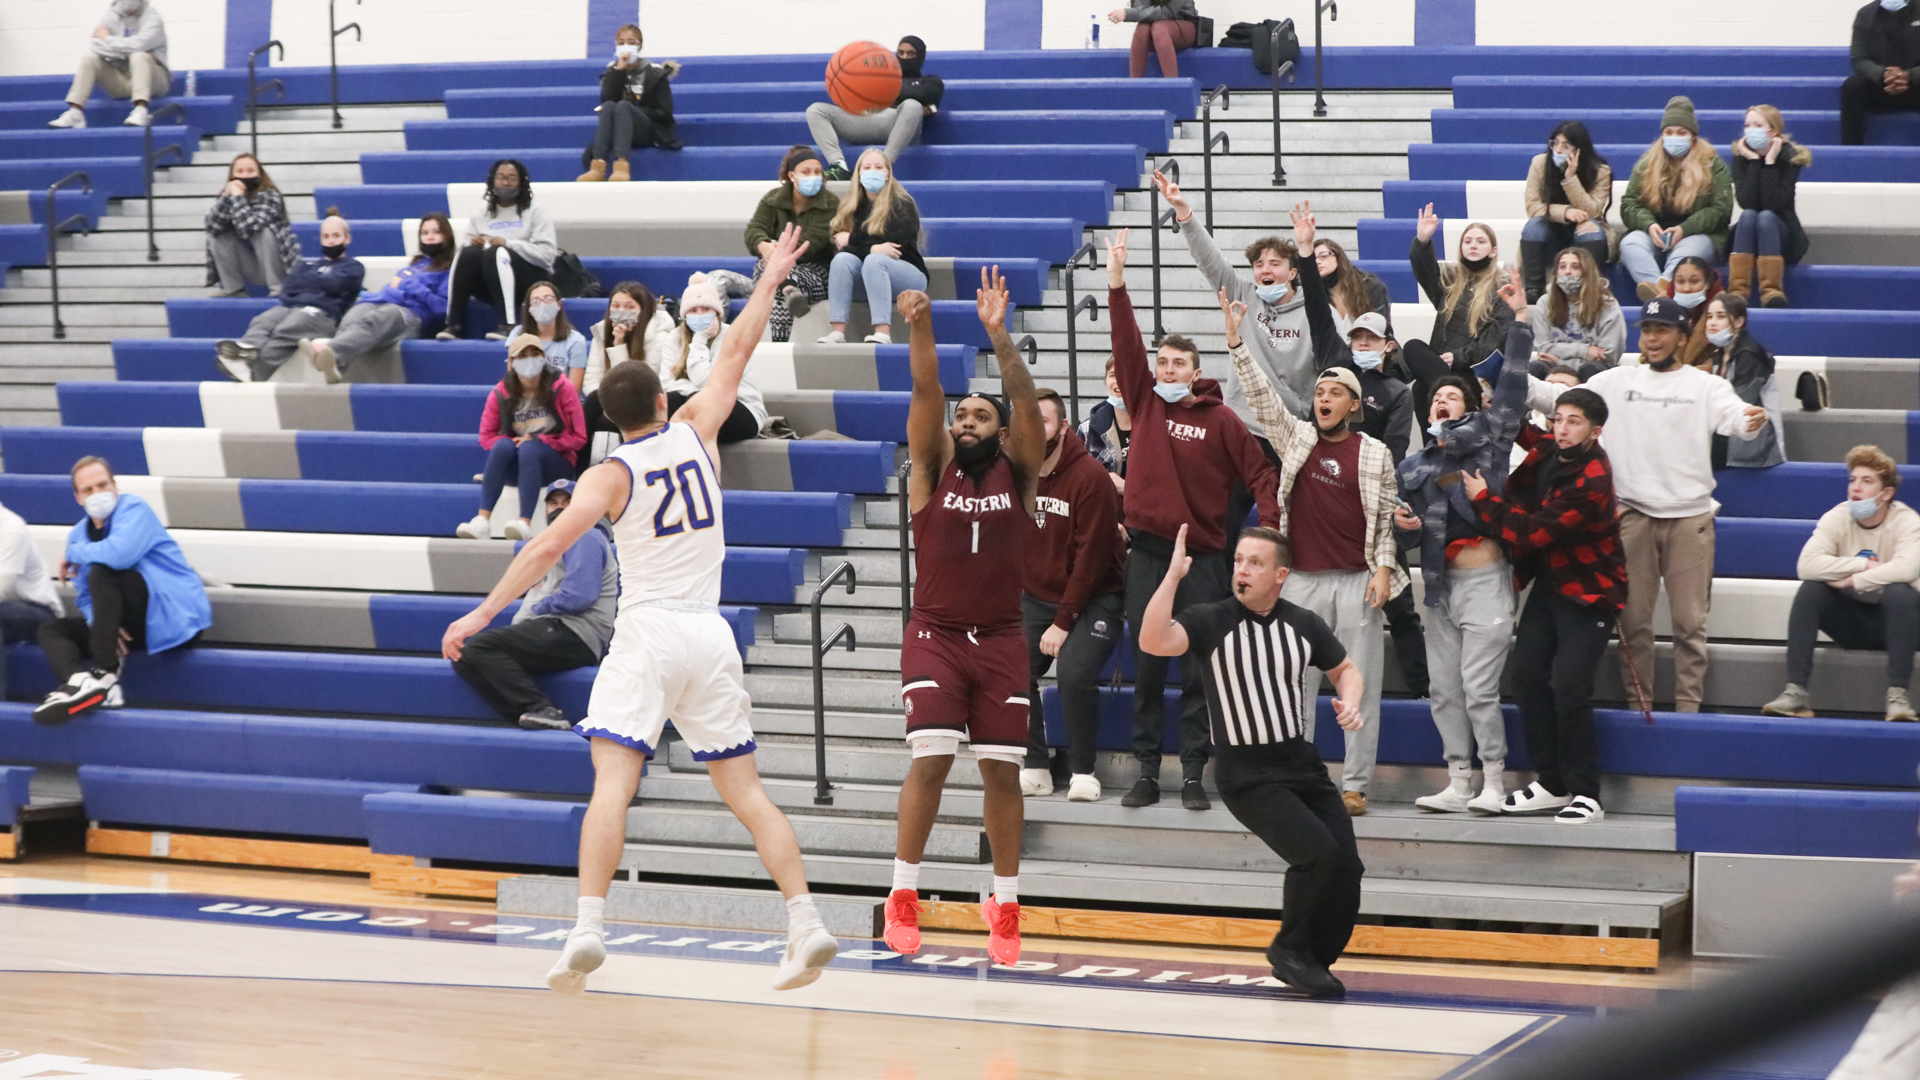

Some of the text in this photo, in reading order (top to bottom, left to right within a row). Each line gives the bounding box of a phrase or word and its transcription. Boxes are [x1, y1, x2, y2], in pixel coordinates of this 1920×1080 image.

[1646, 301, 1660, 314] NY
[1257, 312, 1300, 338] EATERN
[1623, 390, 1695, 408] Champion
[1165, 419, 1207, 440] TERN
[644, 458, 715, 539] 20
[942, 491, 1012, 513] EASTERN
[971, 520, 980, 554] 1
